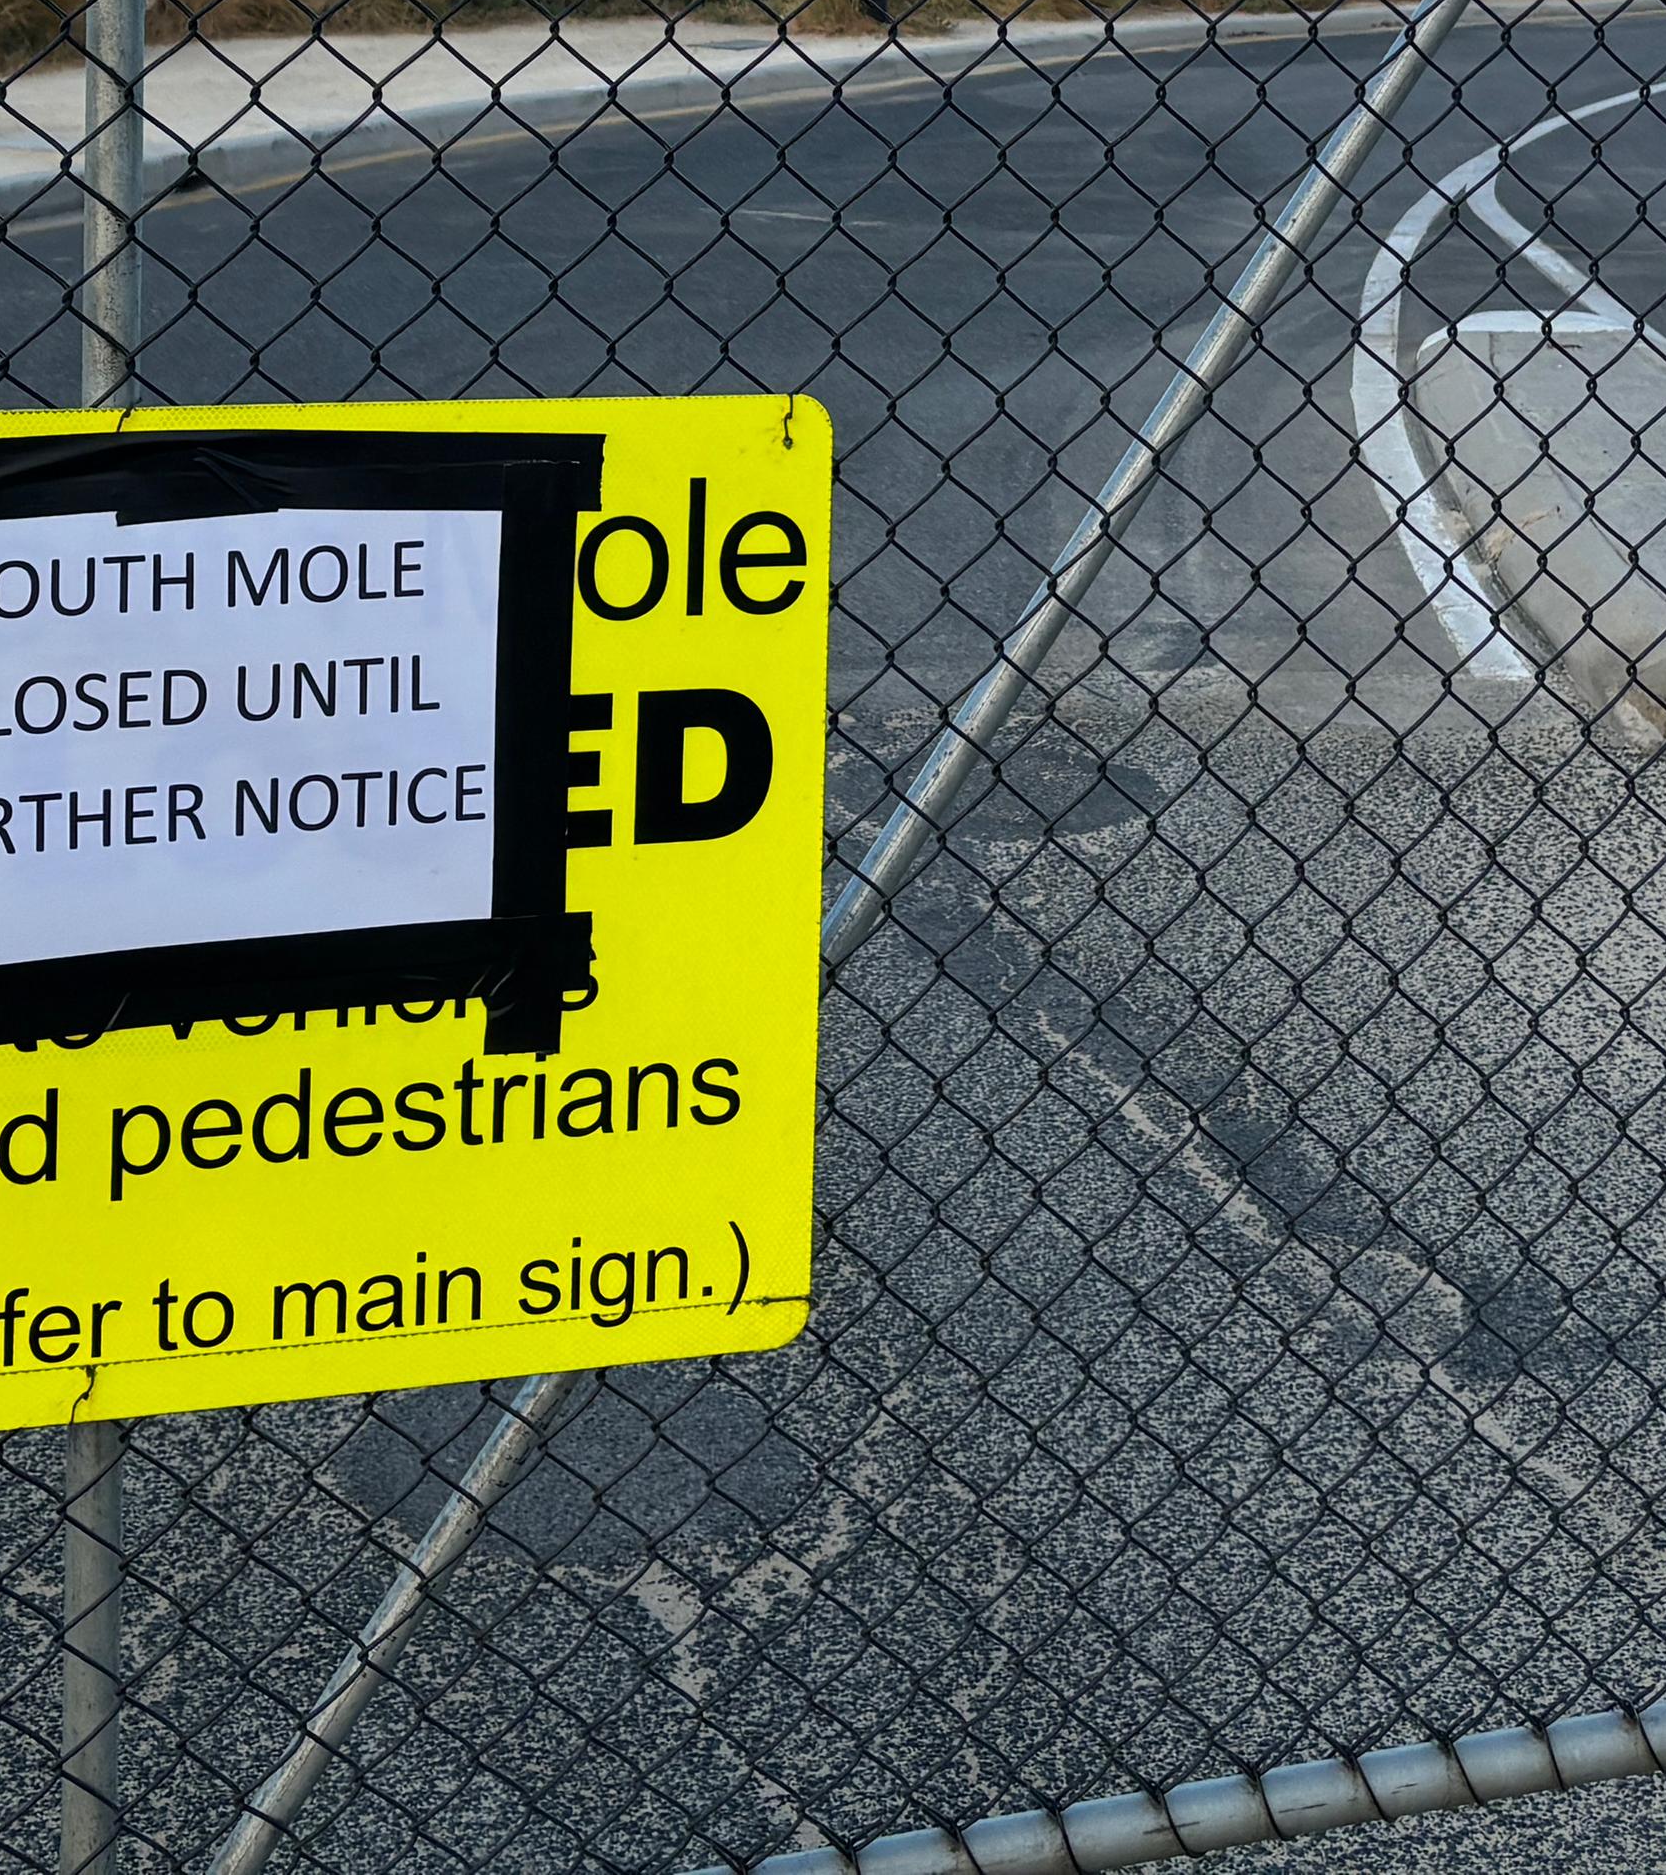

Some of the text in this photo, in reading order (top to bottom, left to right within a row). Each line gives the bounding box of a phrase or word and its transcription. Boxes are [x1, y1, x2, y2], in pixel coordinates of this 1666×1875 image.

[227, 540, 425, 608] MOLE
[576, 476, 808, 622] ole
[237, 654, 441, 722] UNTIL
[235, 763, 487, 837] NOTICE
[566, 687, 774, 849] ED
[110, 1053, 741, 1202] pedestrians
[152, 1278, 235, 1352] to
[272, 1251, 482, 1341] main
[518, 1220, 750, 1328] sign.)
